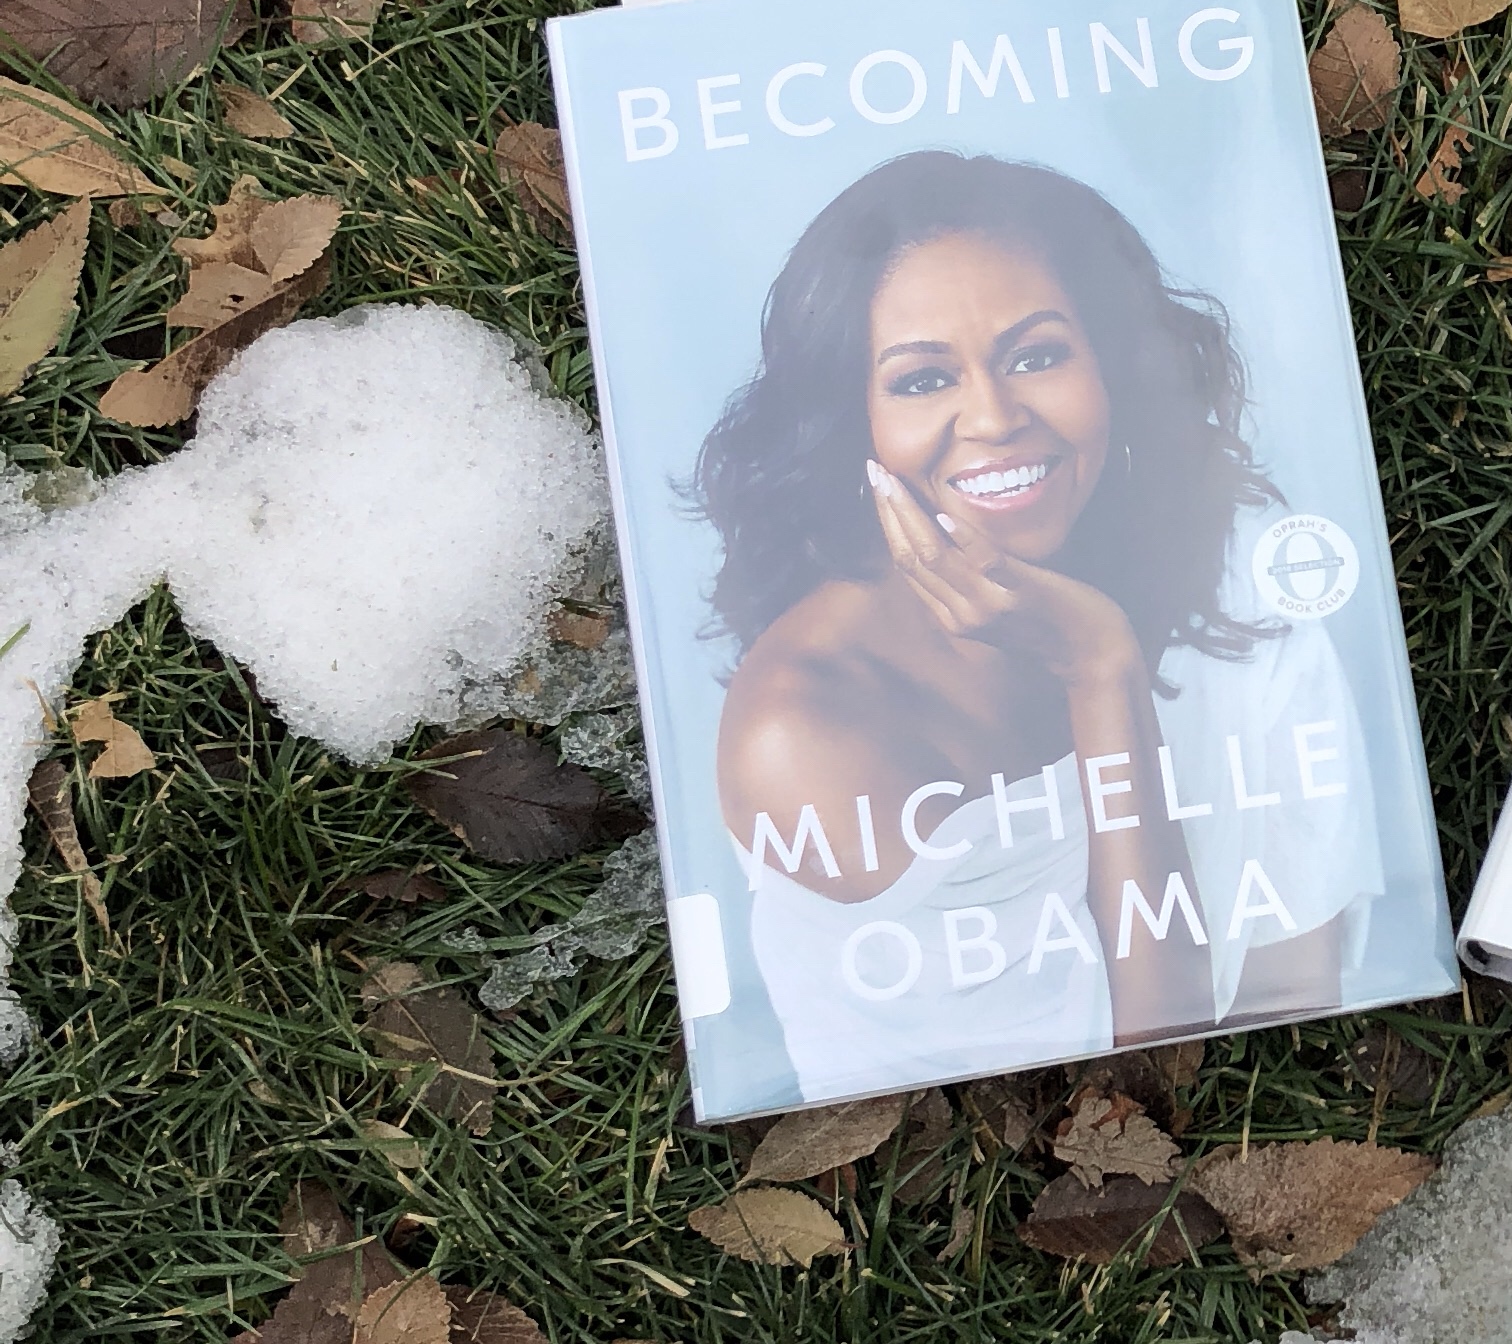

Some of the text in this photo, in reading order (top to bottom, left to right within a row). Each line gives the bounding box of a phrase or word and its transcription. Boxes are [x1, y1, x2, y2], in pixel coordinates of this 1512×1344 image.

[618, 8, 1254, 162] BECOMING
[1273, 520, 1327, 538] OPRAH'S
[1278, 588, 1346, 613] BOOK CLUB
[749, 720, 1347, 891] MICHELLE
[841, 859, 1297, 1001] OBAMA
